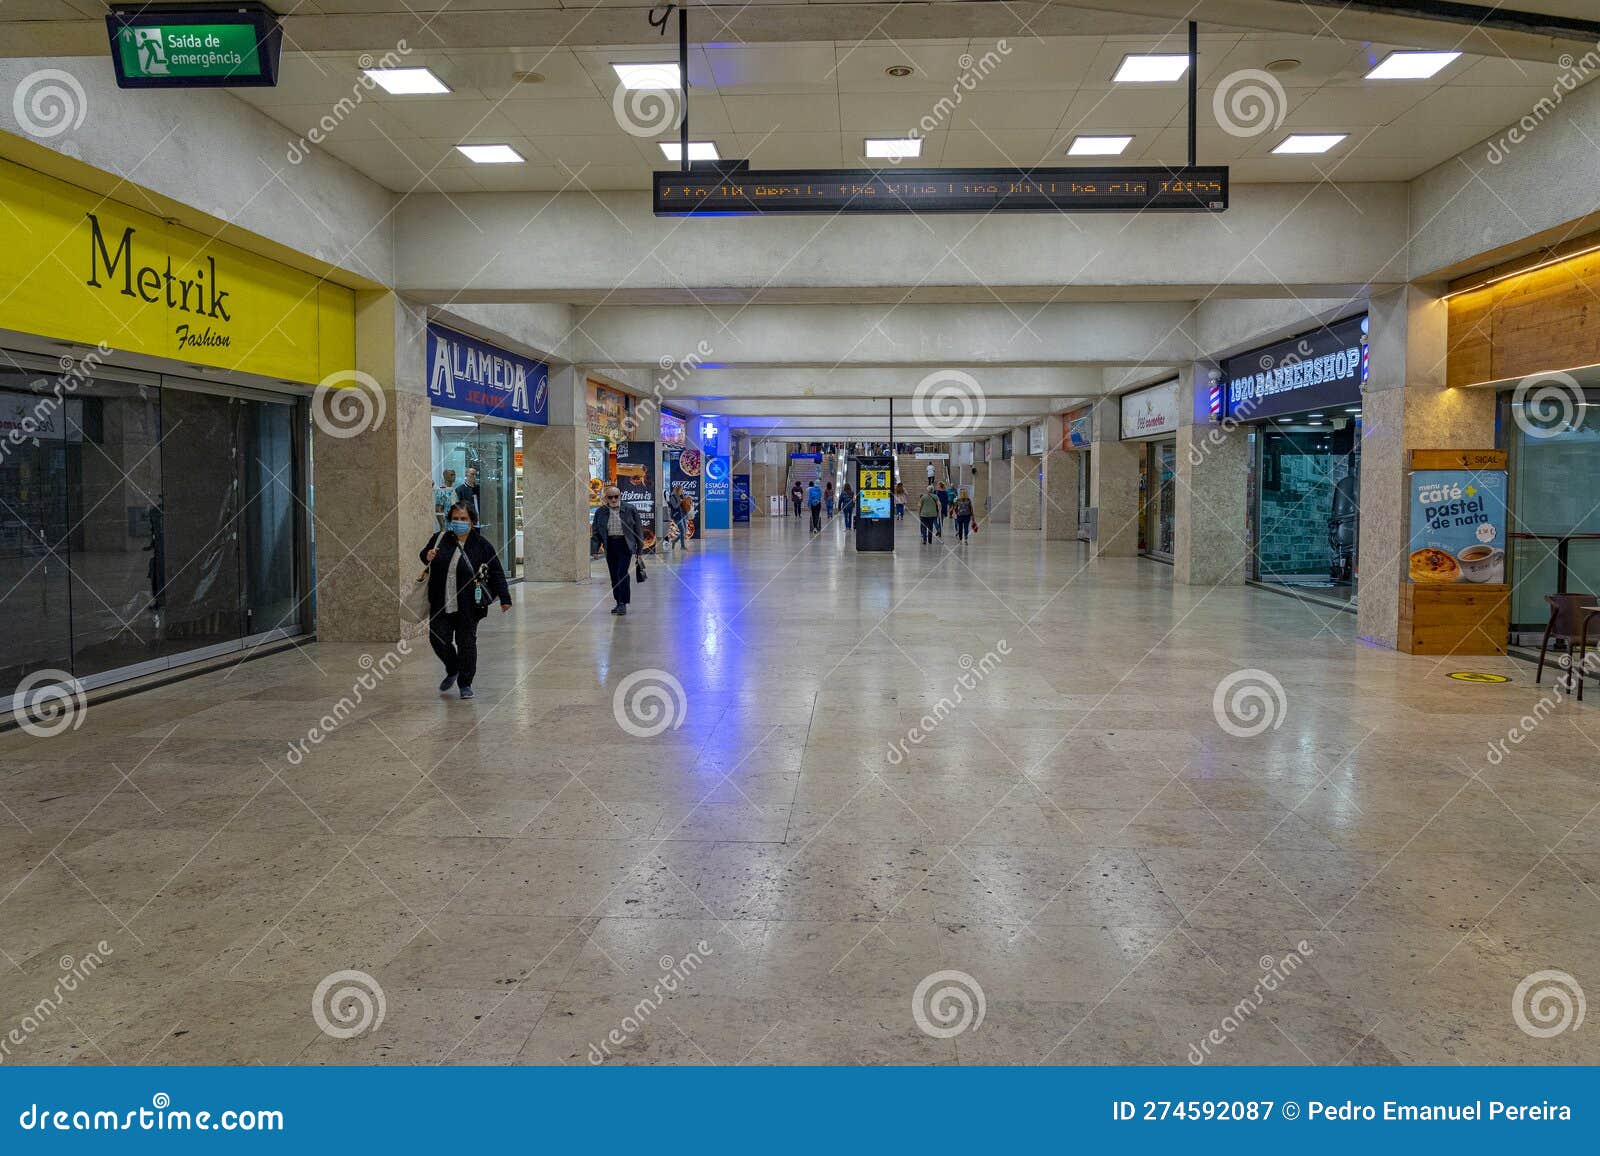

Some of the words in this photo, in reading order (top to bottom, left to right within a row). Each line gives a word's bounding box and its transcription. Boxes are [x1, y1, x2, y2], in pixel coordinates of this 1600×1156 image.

[168, 34, 201, 48] Saída
[204, 34, 221, 48] de
[171, 51, 242, 67] emergência
[86, 212, 231, 321] Metrik
[175, 324, 231, 350] Fashion
[430, 336, 529, 414] ALAMEDA
[1230, 373, 1254, 402] 1920
[1255, 347, 1361, 397] BARBERSHOP
[1418, 483, 1441, 491] menu
[1419, 483, 1462, 503] café
[1425, 496, 1484, 521] pastel
[1431, 519, 1450, 530] de
[1455, 512, 1489, 527] nata
